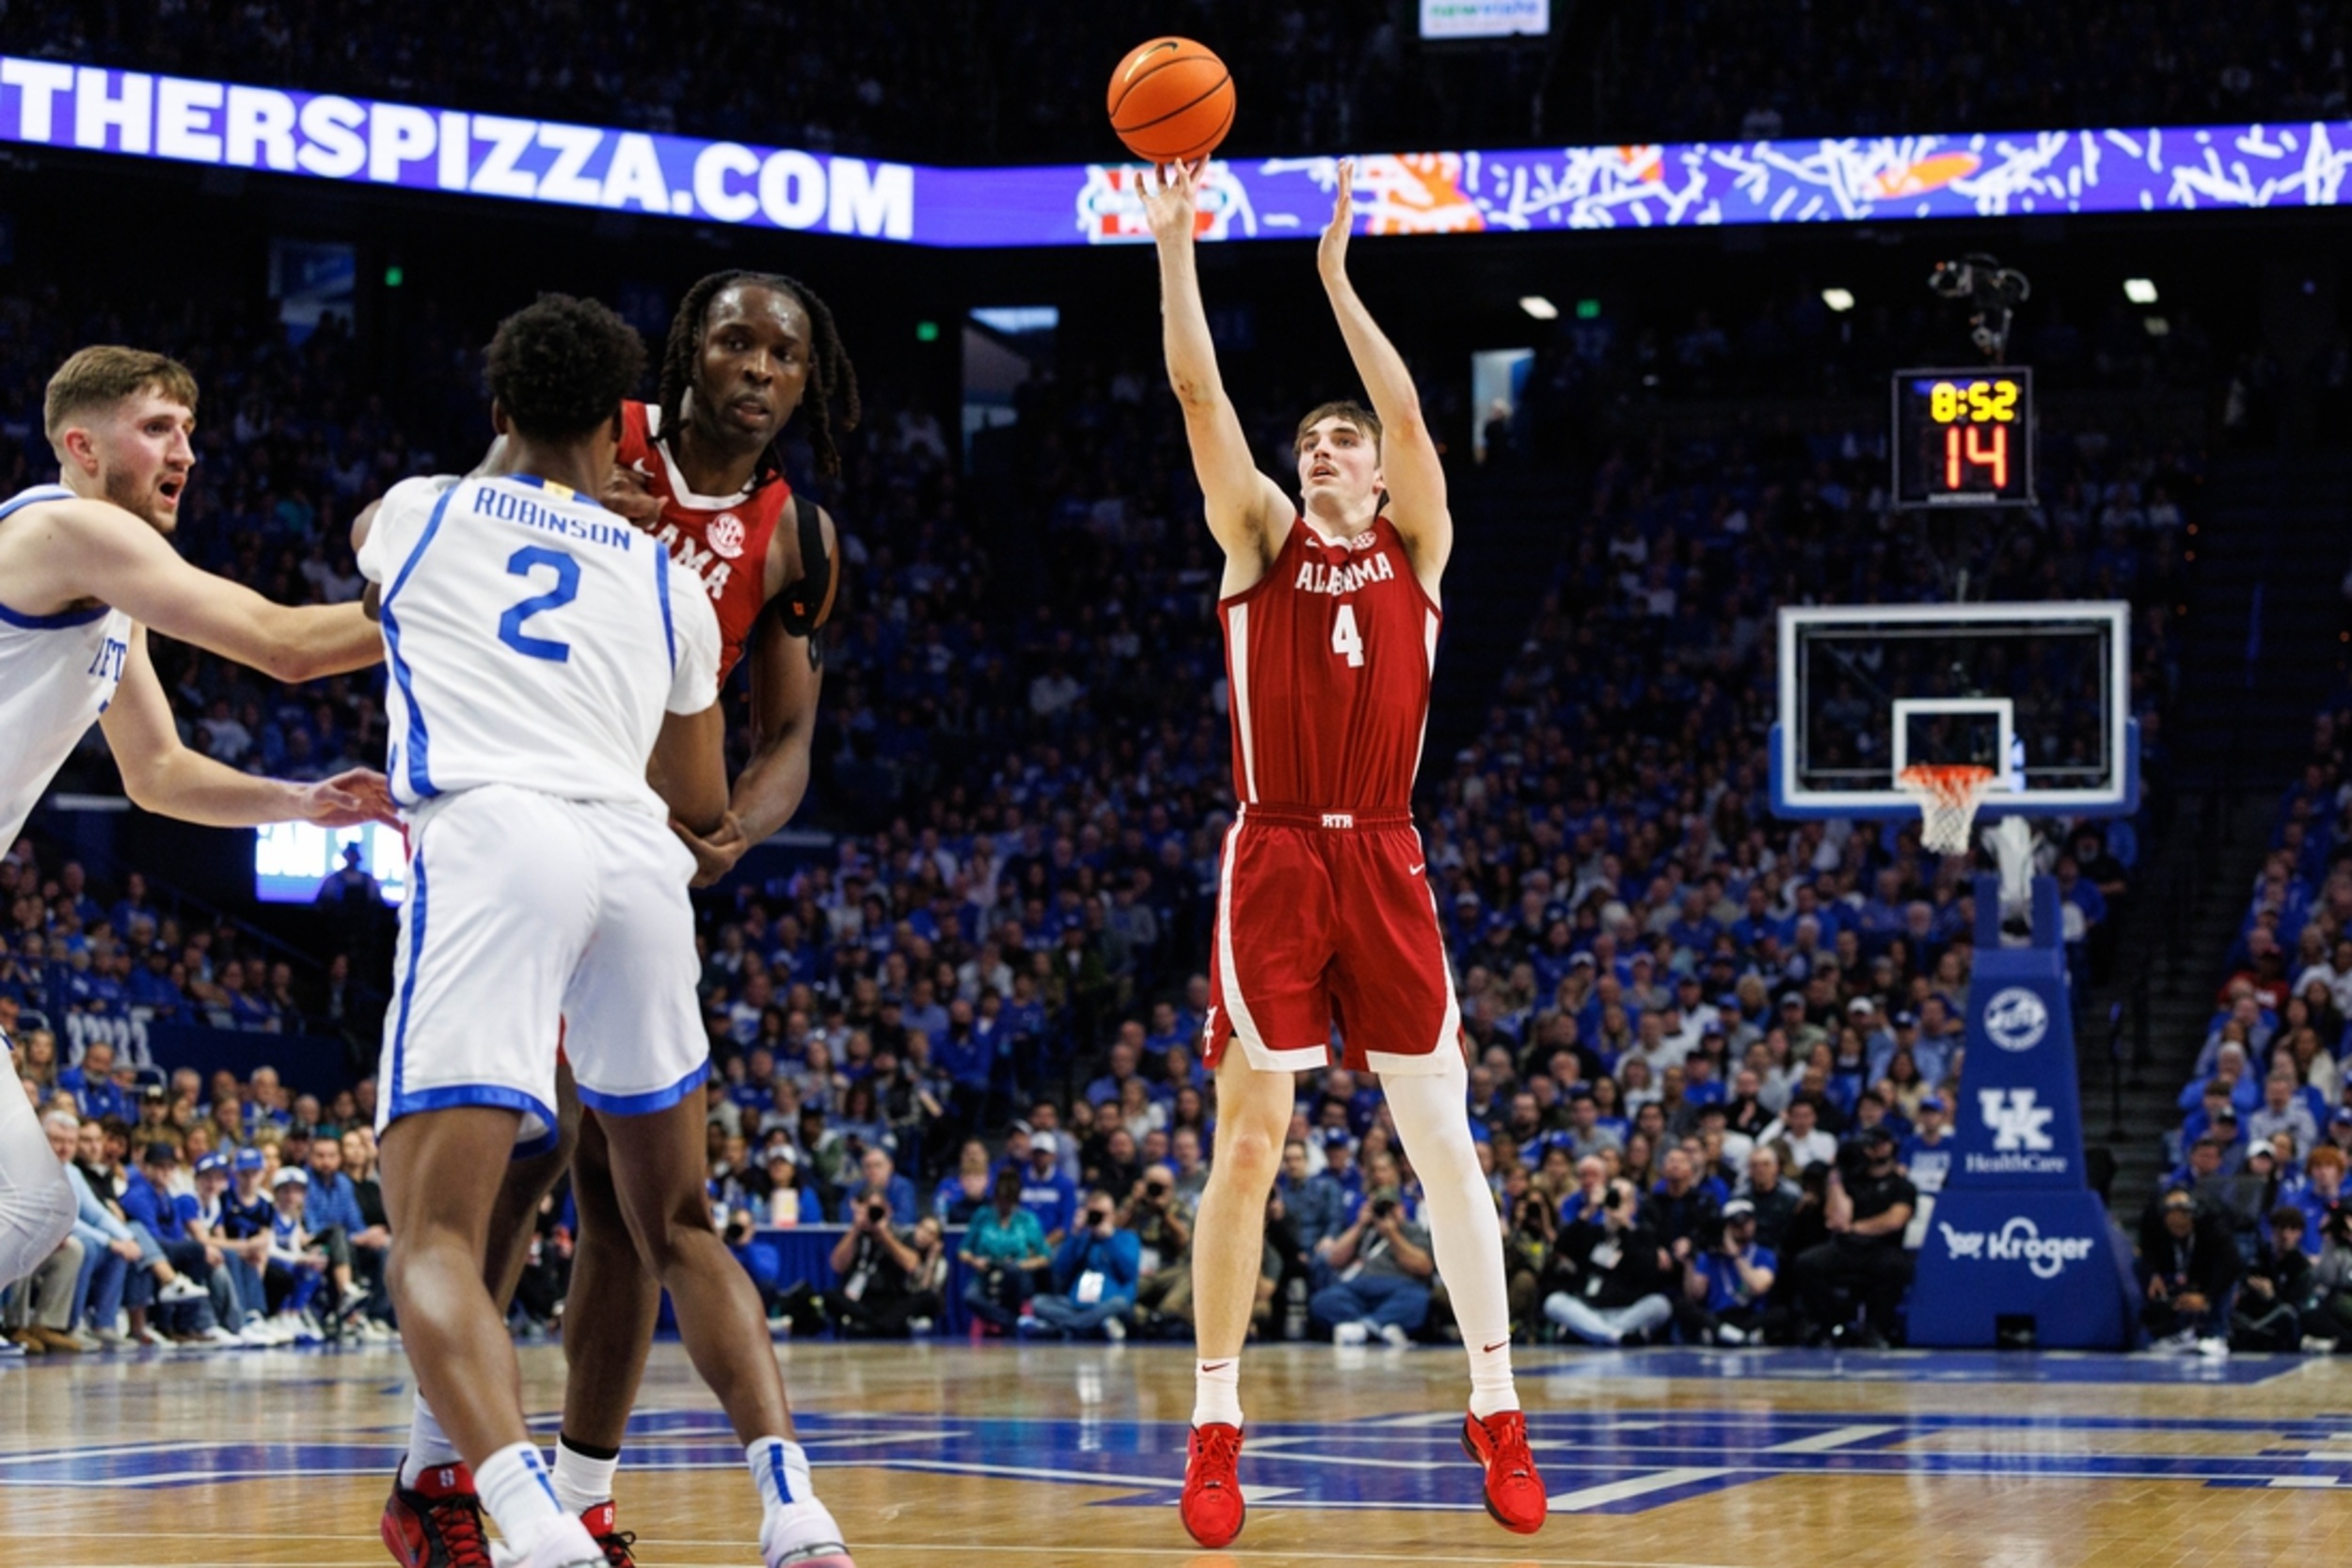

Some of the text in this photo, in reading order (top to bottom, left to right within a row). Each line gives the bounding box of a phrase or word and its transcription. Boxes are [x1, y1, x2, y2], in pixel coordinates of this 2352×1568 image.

[0, 56, 914, 241] THERSPIZZA.COM
[1931, 381, 2017, 422] 8:52
[1947, 425, 2007, 489] 14
[473, 486, 631, 551] ROBINSON
[651, 523, 731, 600] AMA
[498, 545, 580, 663] 2
[1331, 604, 1364, 668] 4
[1322, 814, 1353, 828] RTR
[1979, 1089, 2054, 1150] UK
[1965, 1153, 2066, 1173] HealthCare
[1987, 1217, 2094, 1279] Kroger
